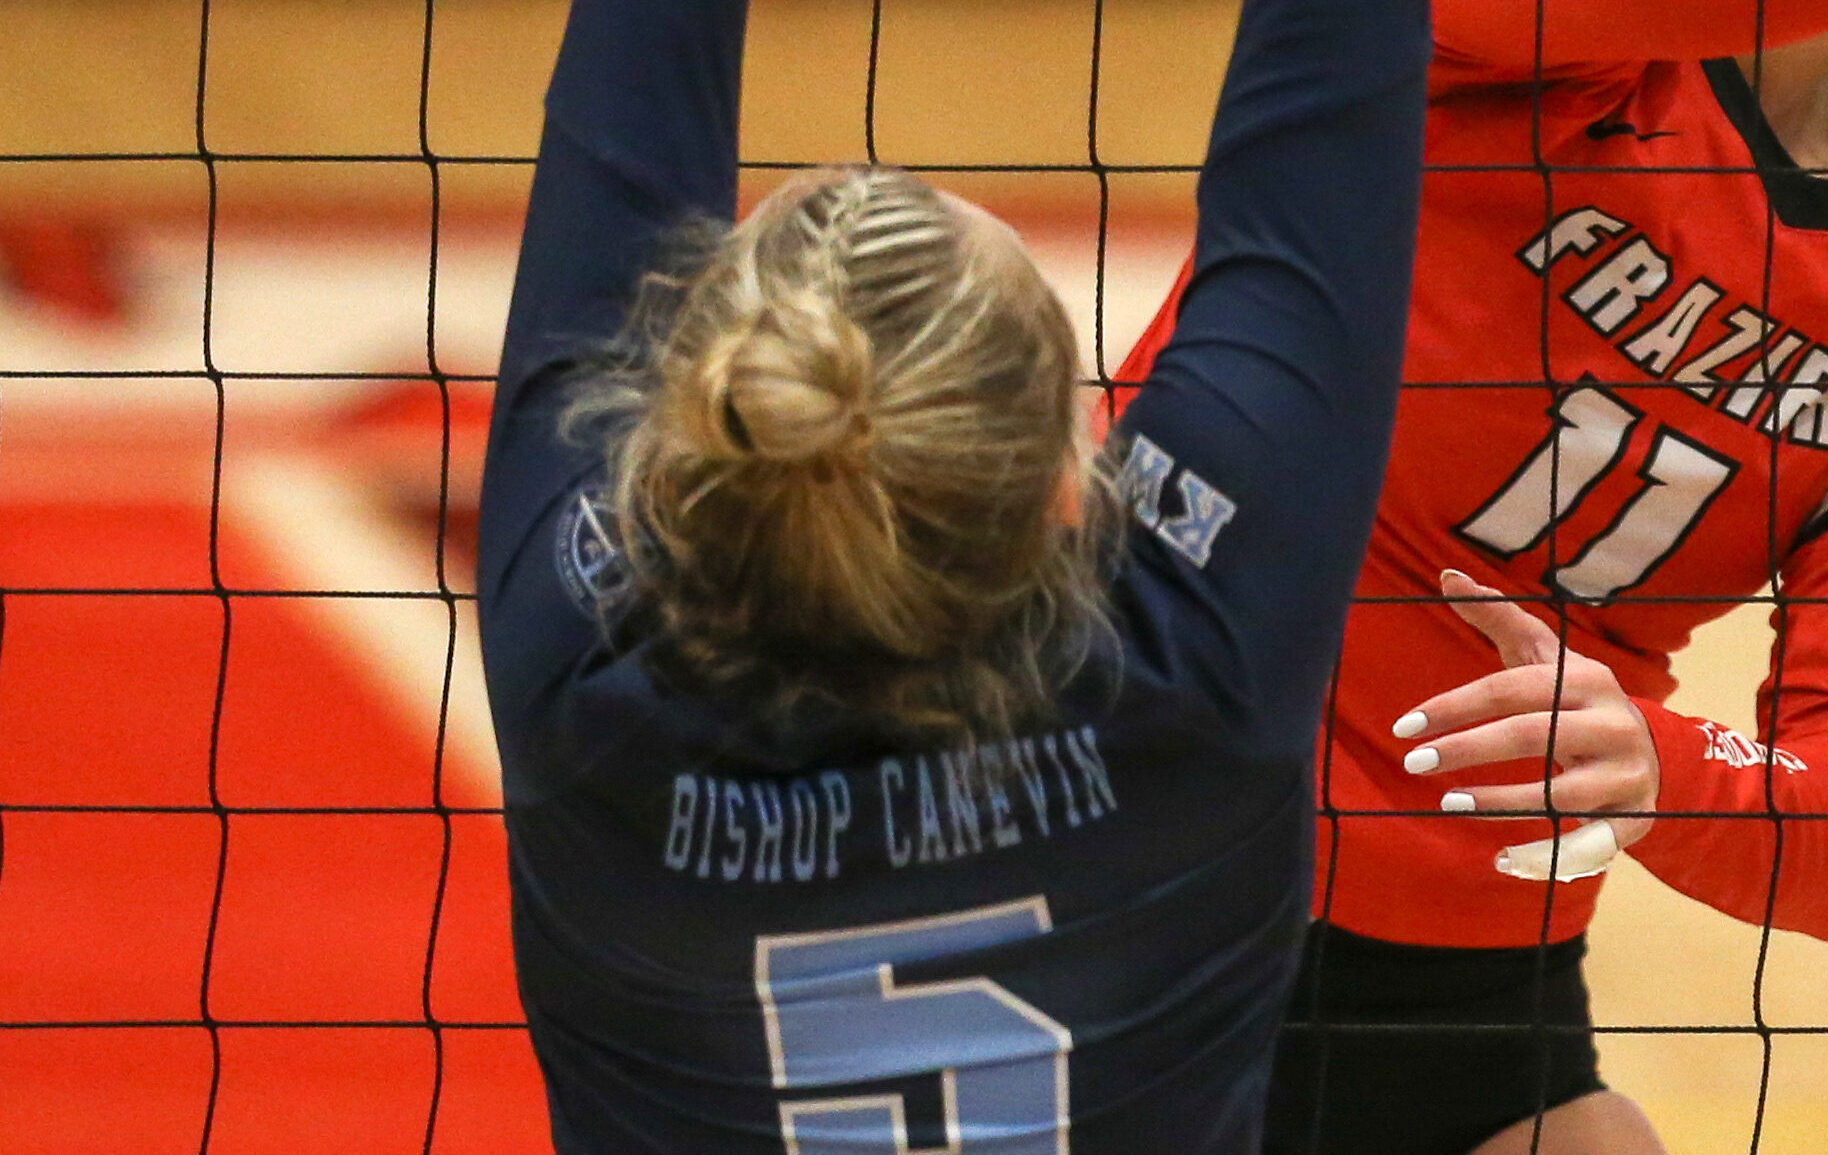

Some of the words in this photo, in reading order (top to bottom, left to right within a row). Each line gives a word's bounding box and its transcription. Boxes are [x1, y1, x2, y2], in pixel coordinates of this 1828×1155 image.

[1450, 371, 1741, 606] 11
[663, 772, 853, 883] BISHOP
[880, 724, 1118, 869] CANEVIN
[755, 893, 1073, 1155] 5
